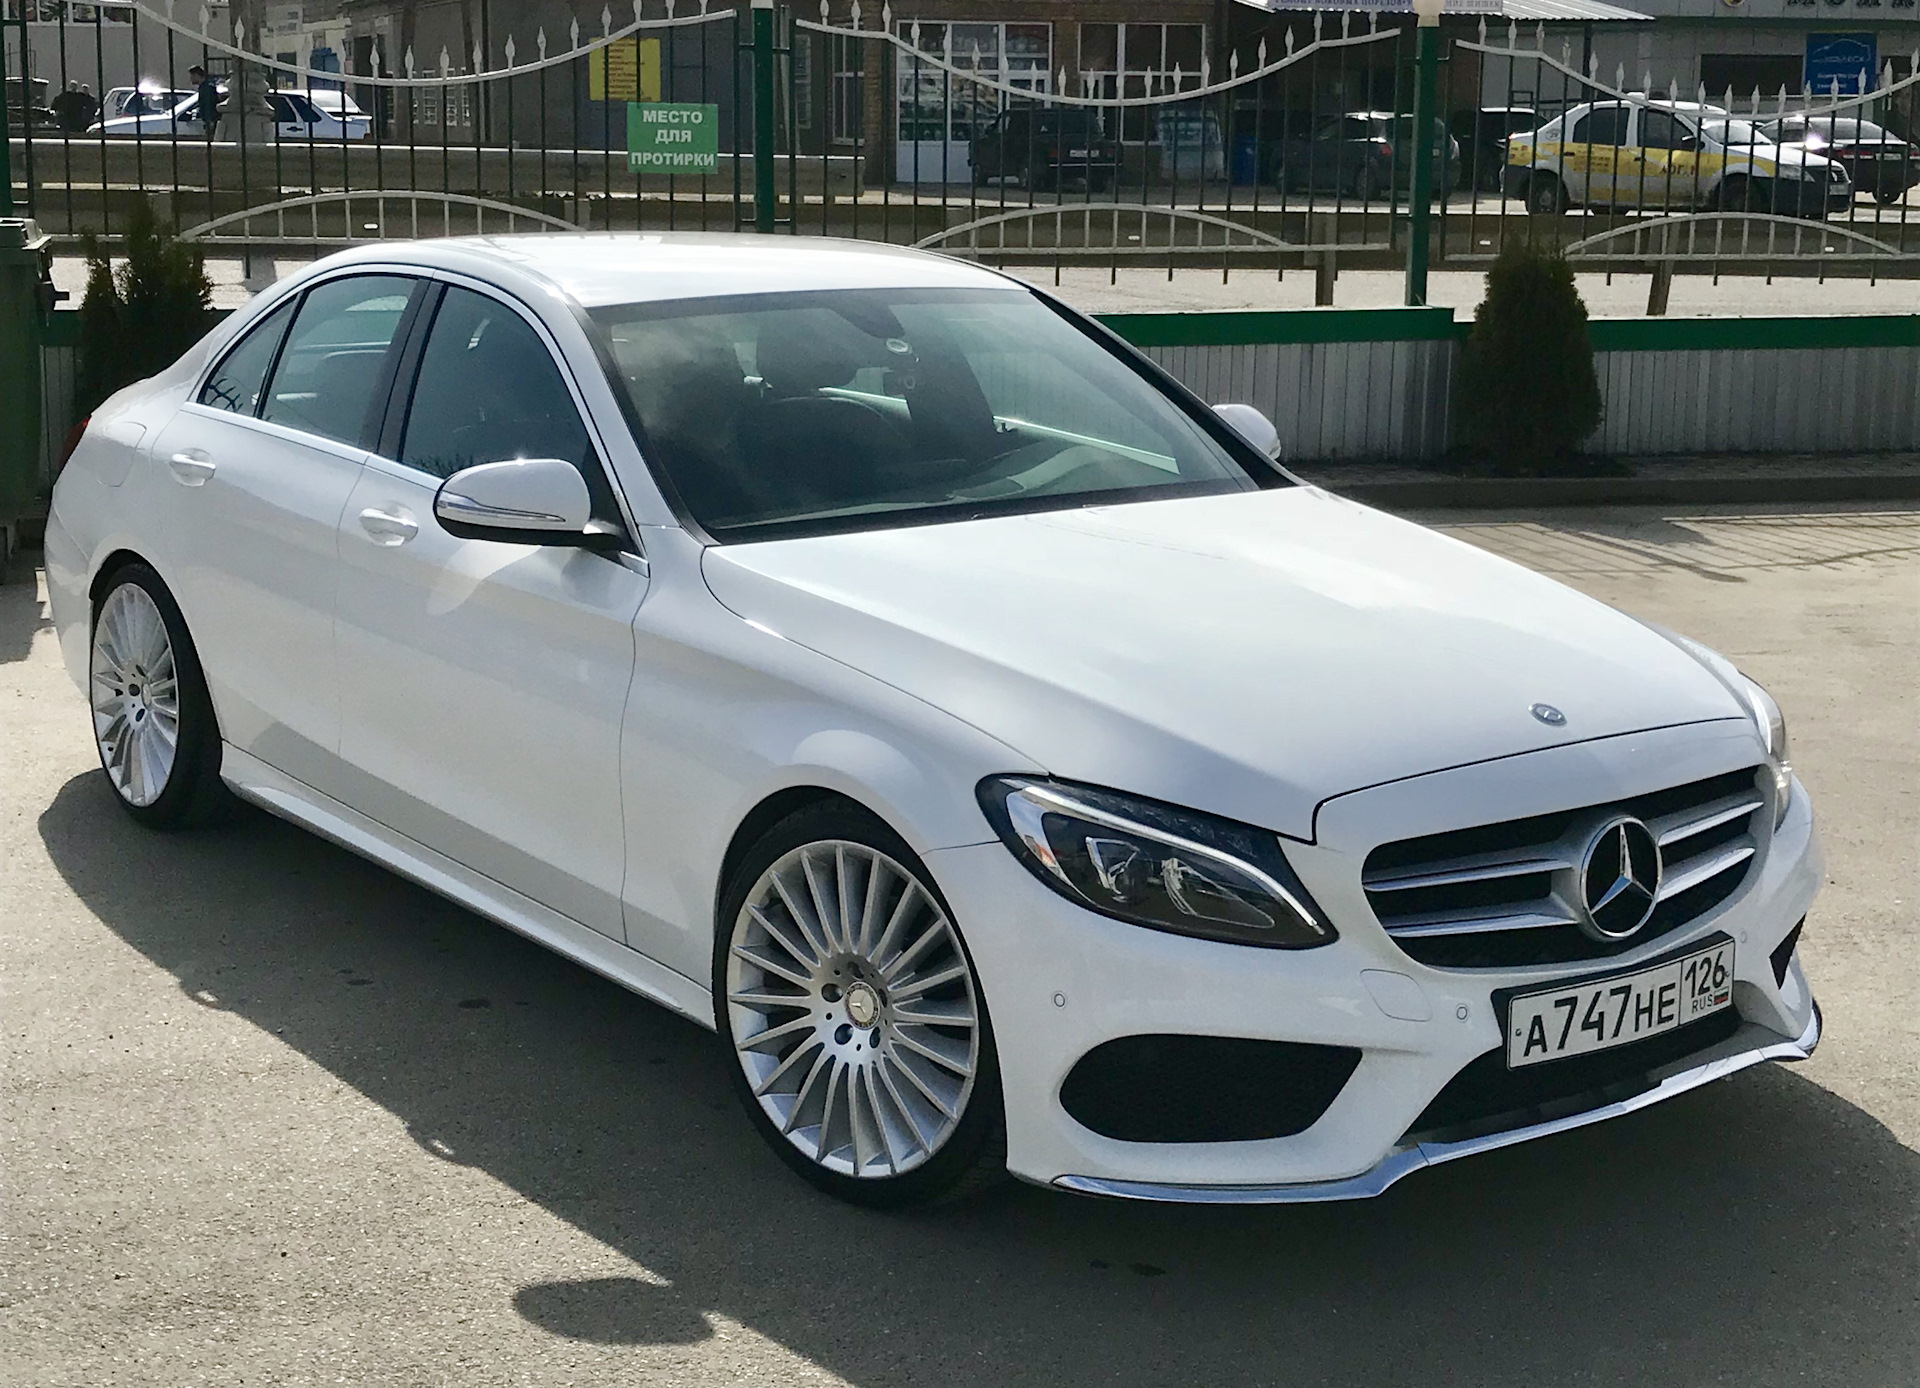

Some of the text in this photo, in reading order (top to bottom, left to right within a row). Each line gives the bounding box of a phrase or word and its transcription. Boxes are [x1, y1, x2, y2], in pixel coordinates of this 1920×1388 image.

[642, 109, 703, 124] МЕСТО
[655, 129, 692, 144] ДЛЯ
[631, 152, 715, 167] ПРОТИРКИ
[1685, 950, 1725, 998] 126
[1692, 993, 1713, 1014] RUS
